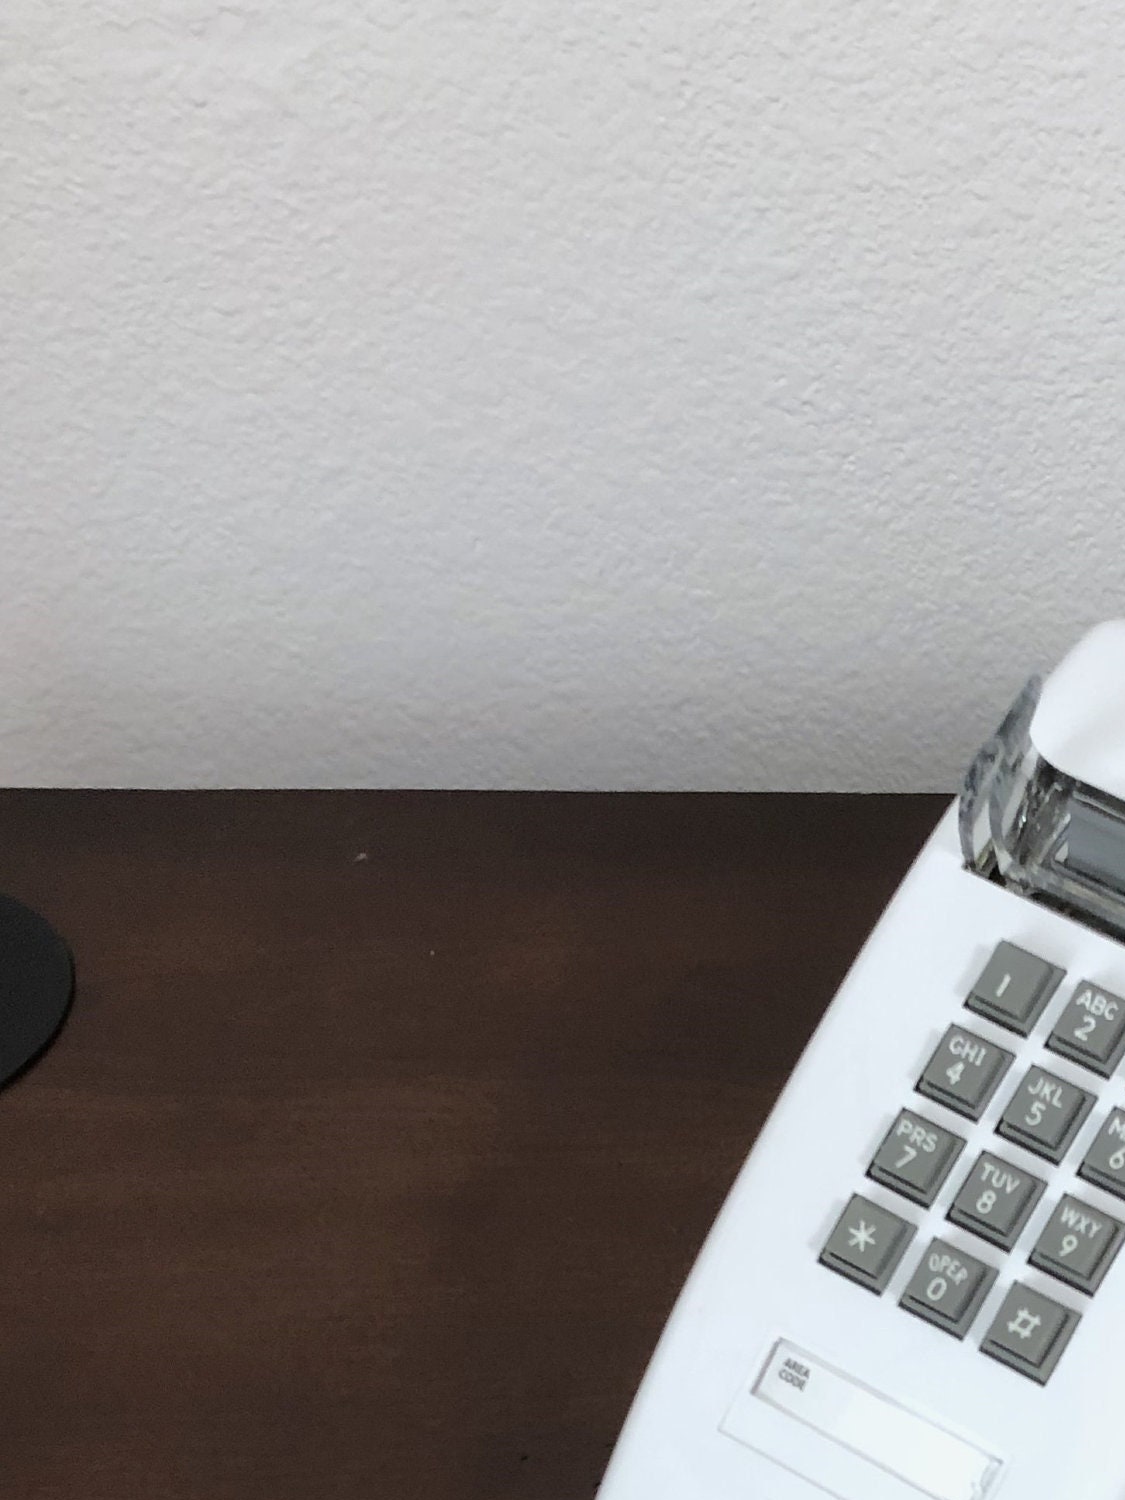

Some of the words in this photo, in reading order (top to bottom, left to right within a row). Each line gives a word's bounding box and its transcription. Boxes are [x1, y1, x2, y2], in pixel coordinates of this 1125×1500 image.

[1076, 989, 1119, 1021] ABC
[1073, 1016, 1096, 1042] 2
[949, 1034, 986, 1066] GHI
[946, 1062, 965, 1085] 4
[1027, 1077, 1063, 1109] JKL
[1025, 1102, 1046, 1126] 5
[896, 1119, 938, 1153] PRS
[895, 1145, 917, 1169] 7
[981, 1162, 1020, 1194] TUV
[975, 1190, 997, 1214] 8
[1060, 1207, 1101, 1239] WXY
[1058, 1234, 1078, 1257] 9
[928, 1253, 968, 1286] OPER
[926, 1278, 947, 1301] 0
